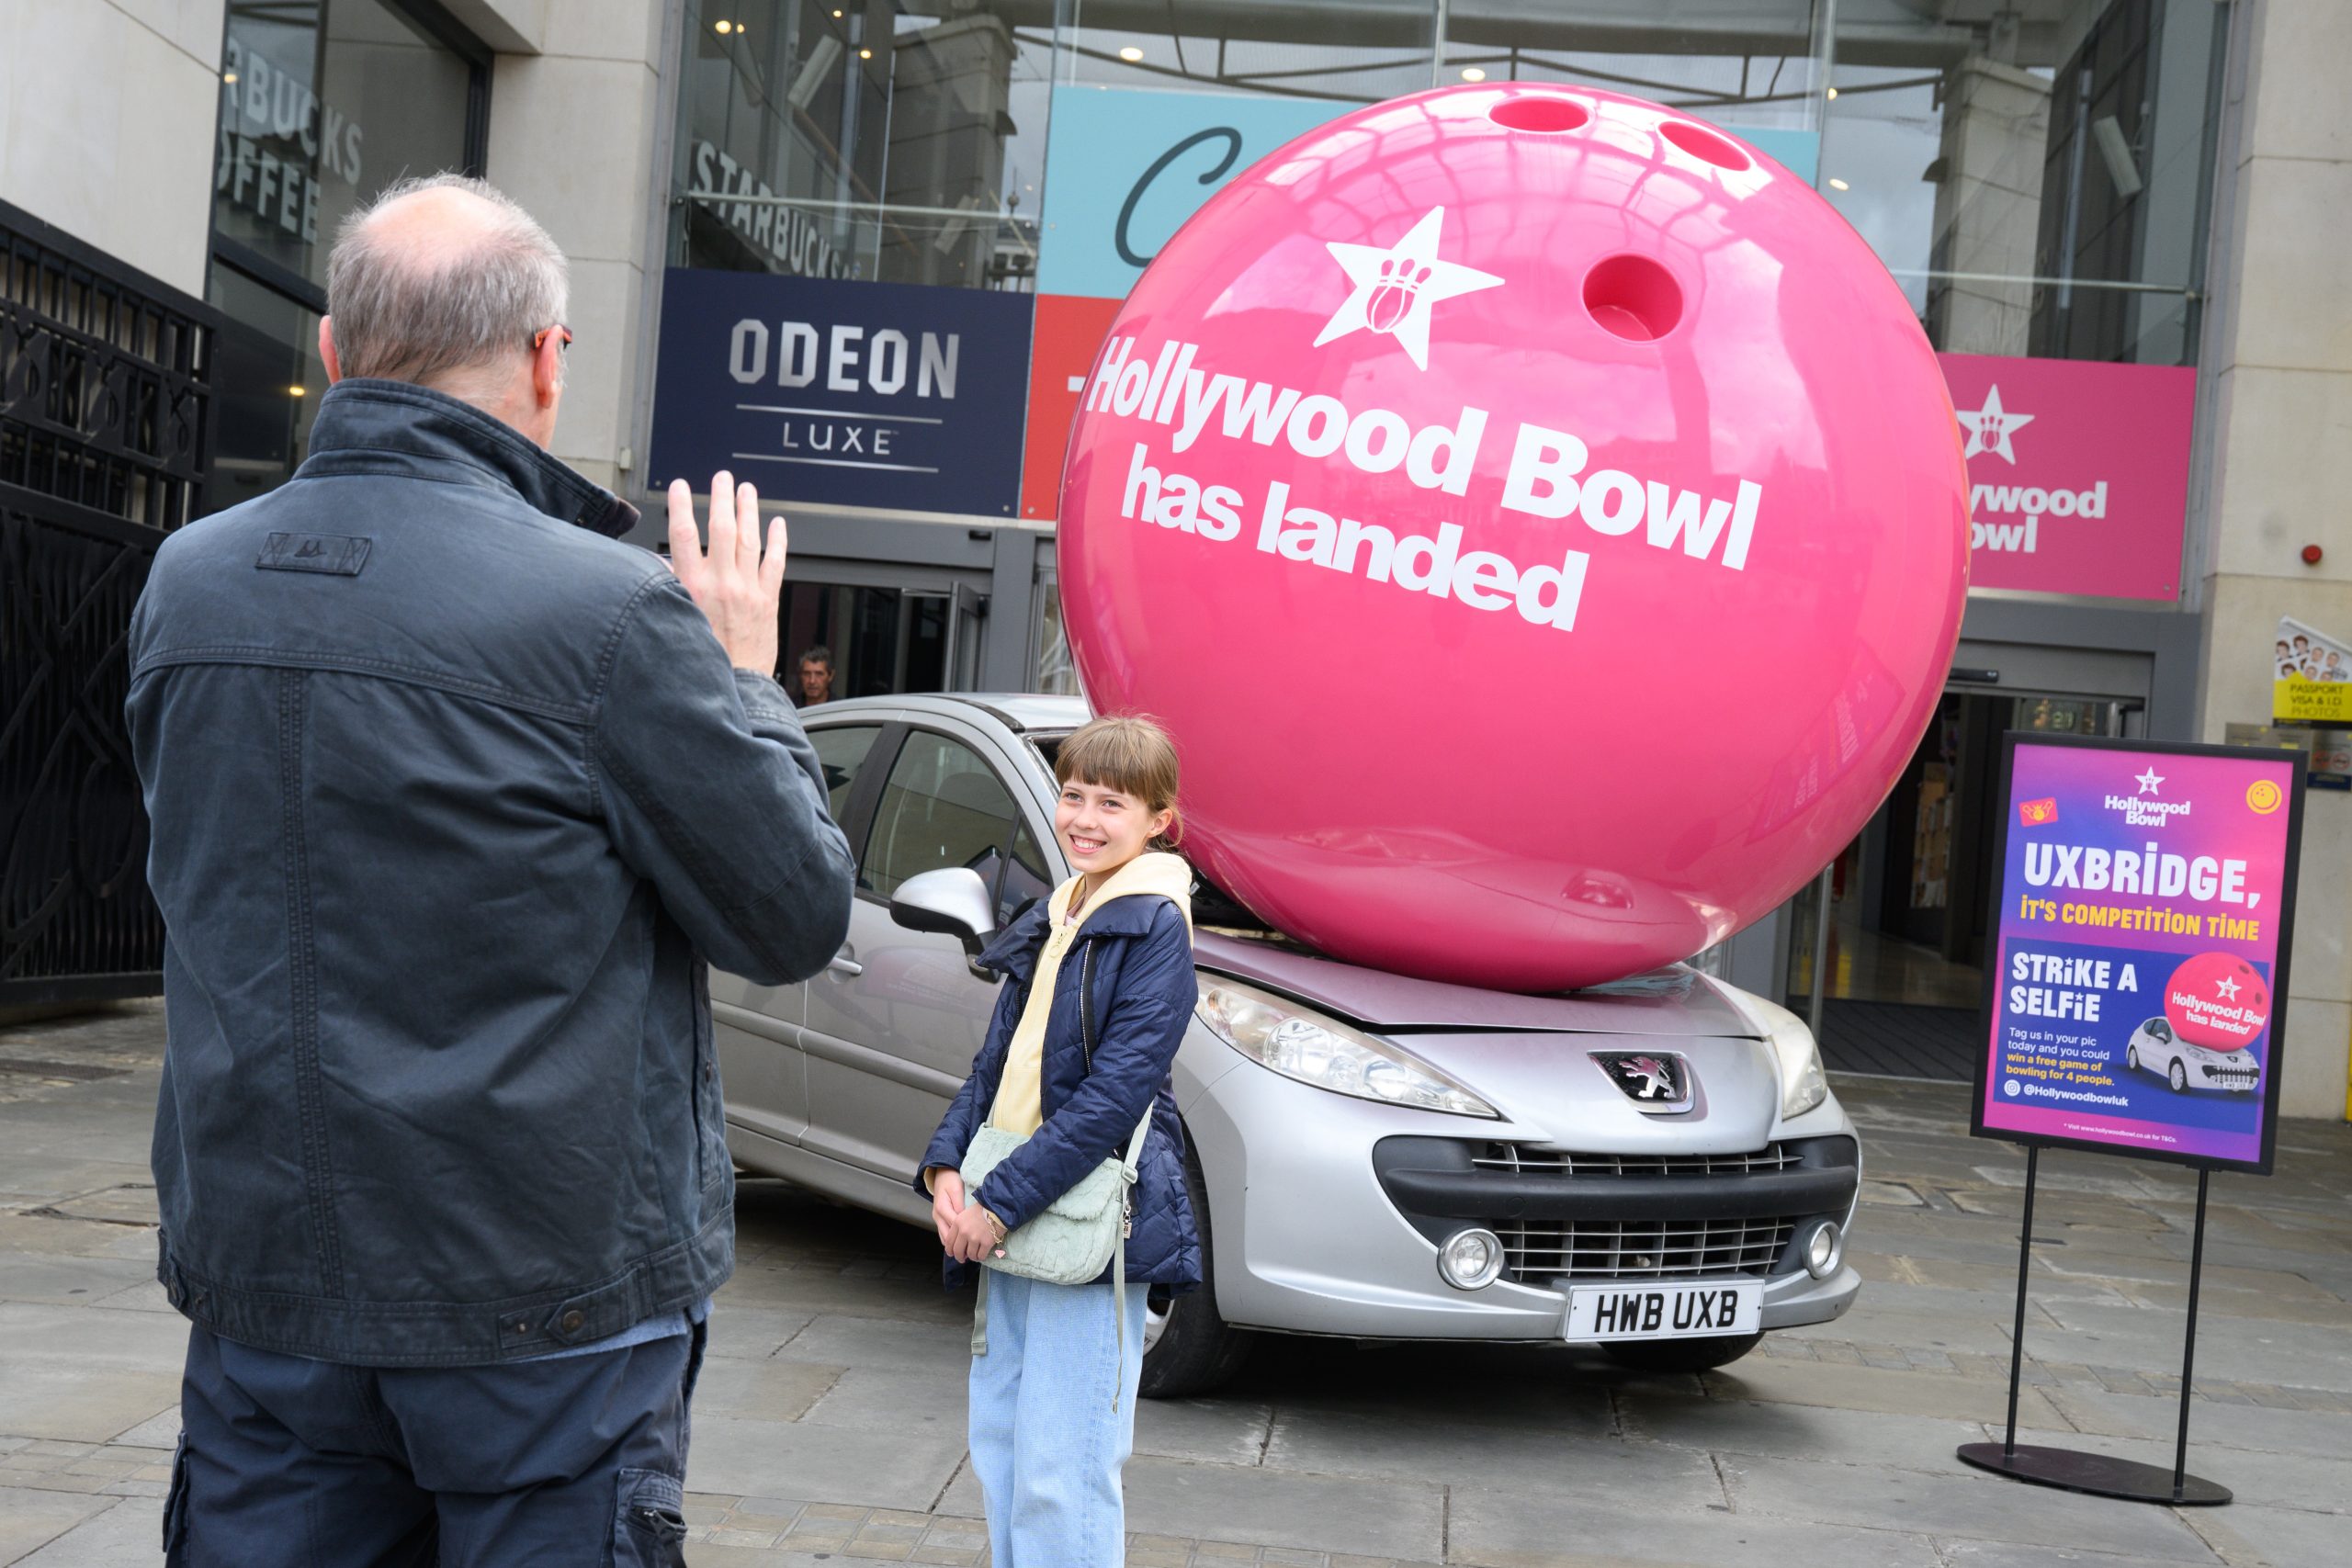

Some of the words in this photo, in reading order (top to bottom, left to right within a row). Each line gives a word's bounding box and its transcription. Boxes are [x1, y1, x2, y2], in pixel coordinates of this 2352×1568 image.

[729, 318, 960, 399] ODEON
[1086, 336, 1489, 497] Hollywood
[1500, 422, 1762, 571] Bowl
[1121, 442, 1244, 542] has
[1256, 479, 1590, 632] landed
[2290, 682, 2344, 694] PASSPORT
[2290, 695, 2313, 705] VISA
[2316, 696, 2324, 706] &
[2291, 705, 2341, 717] PHOTOS
[2105, 795, 2190, 816] Hollywood
[2125, 812, 2166, 827] Bowl
[2117, 964, 2138, 992] A
[2173, 992, 2243, 1020] Hollywood
[2244, 1010, 2266, 1026] Bowl
[2187, 1010, 2208, 1025] has
[2211, 1017, 2250, 1034] landed
[2009, 1027, 2027, 1040] Tag
[2030, 1031, 2041, 1040] us
[2044, 1031, 2053, 1042] in
[2056, 1034, 2078, 1044] your
[2081, 1035, 2097, 1046] pic
[2007, 1040, 2036, 1054] today
[2038, 1044, 2058, 1055] and
[2061, 1047, 2079, 1057] you
[2082, 1050, 2110, 1060] could
[2007, 1053, 2026, 1064] win
[2027, 1055, 2034, 1065] a
[2036, 1055, 2057, 1066] free
[2059, 1060, 2088, 1070] game
[2090, 1062, 2103, 1072] of
[2006, 1065, 2047, 1080] bowling
[2049, 1069, 2064, 1080] for
[2066, 1071, 2074, 1081] 4
[2075, 1074, 2115, 1087] people.
[2024, 1084, 2129, 1106] @Hollywoodbowluk
[2081, 1125, 2151, 1139] www.hollywoodbowl.co.uk
[1594, 1292, 1665, 1333] HWB
[1672, 1290, 1738, 1330] UXB
